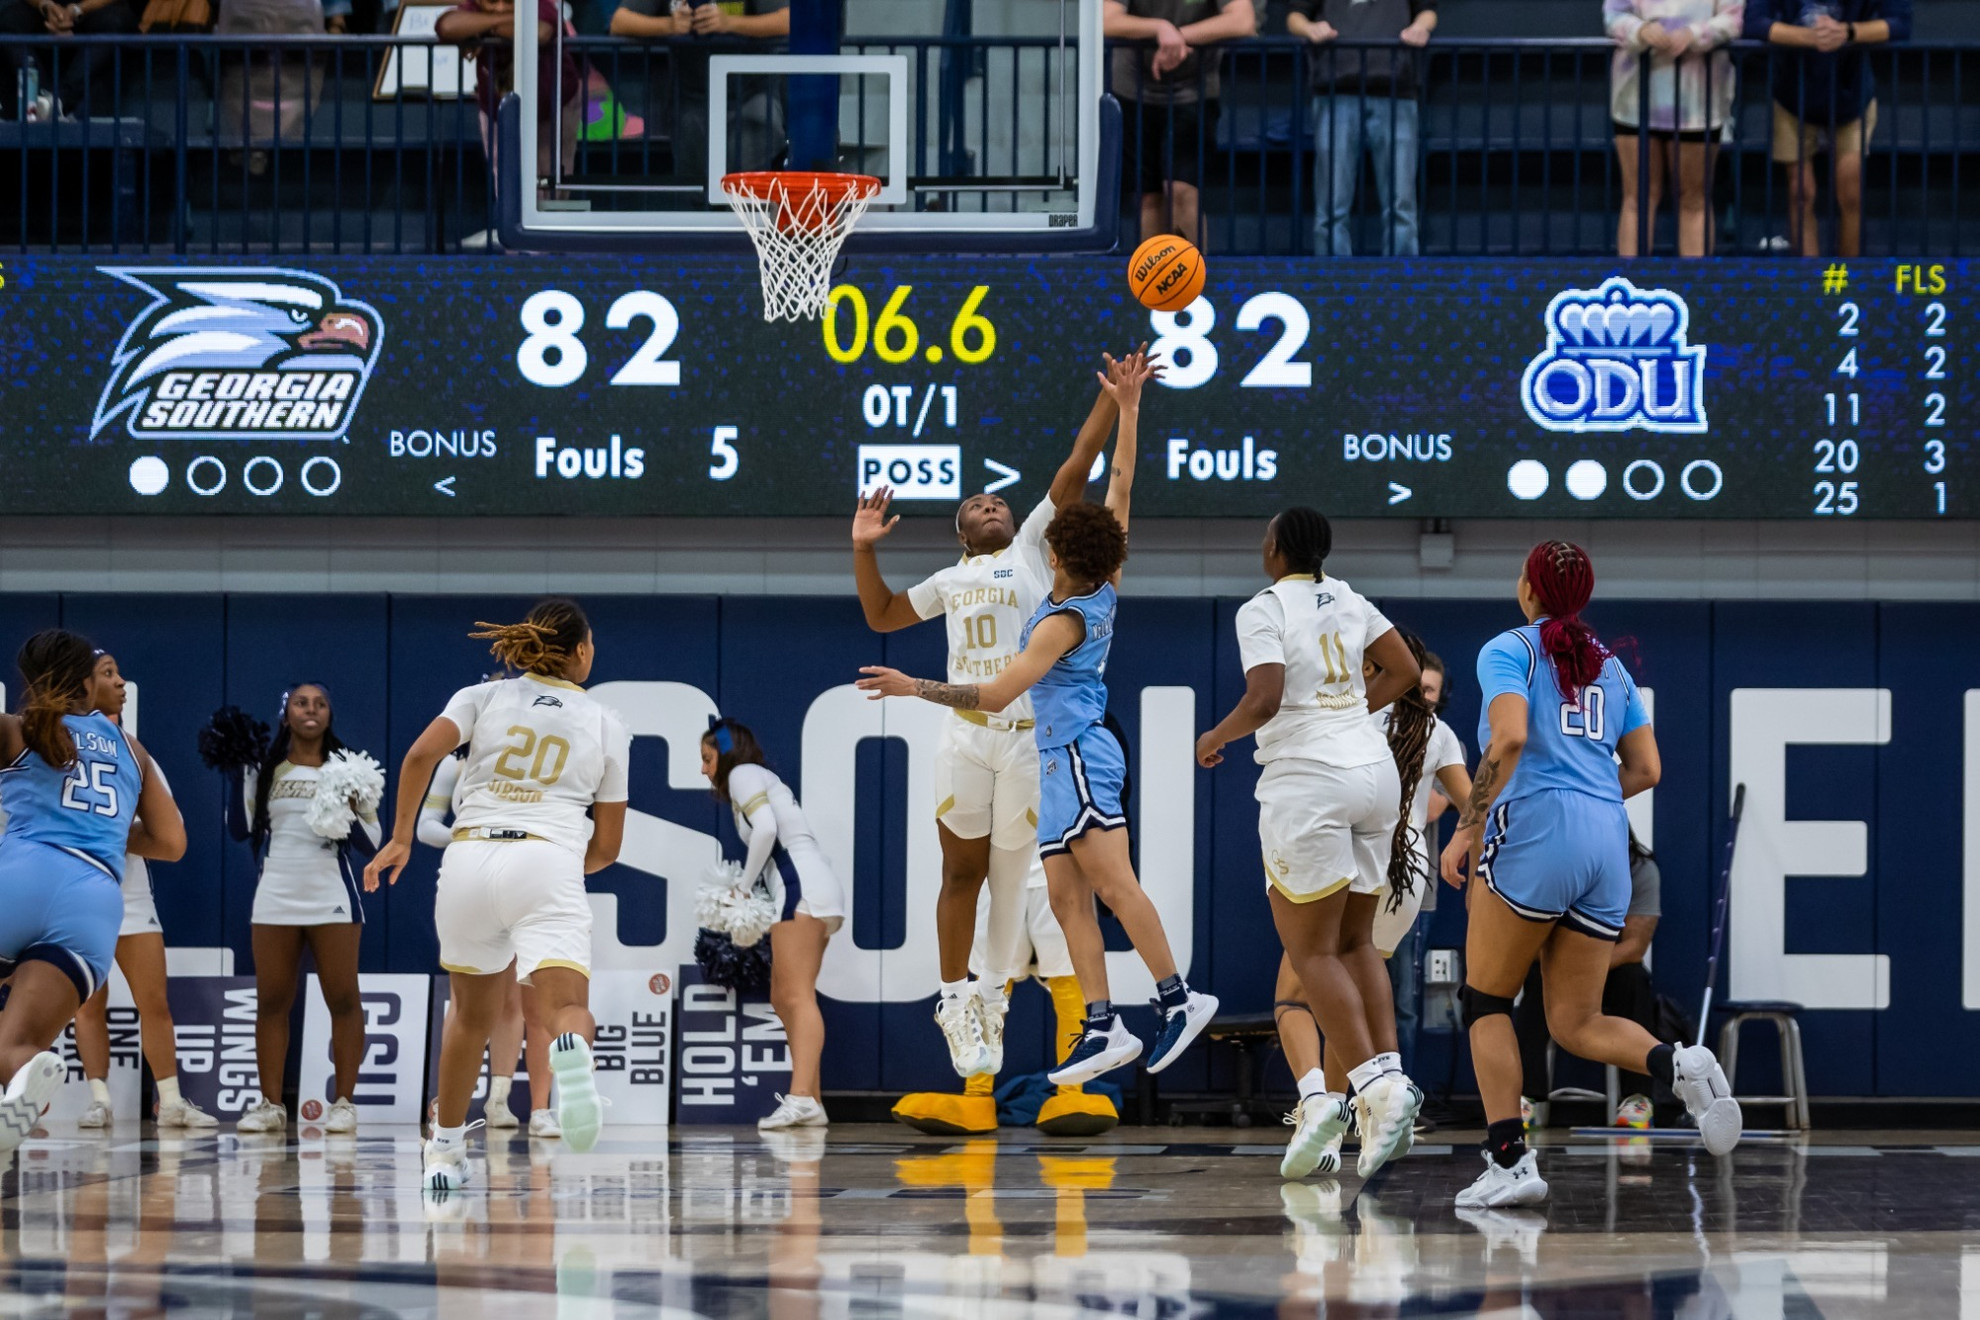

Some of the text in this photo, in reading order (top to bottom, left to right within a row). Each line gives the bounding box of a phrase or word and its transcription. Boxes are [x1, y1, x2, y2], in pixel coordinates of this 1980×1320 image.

[1048, 214, 1078, 228] DRAPER
[1135, 245, 1176, 282] Wilson
[1156, 262, 1188, 295] NCAA
[1895, 265, 1946, 294] FLS
[822, 285, 997, 364] 06.6
[1839, 303, 1946, 335] 2 2
[516, 289, 682, 388] 82
[1151, 290, 1313, 390] 82
[1838, 346, 1946, 378] 4 2
[156, 372, 354, 400] GEORGIA
[1533, 358, 1691, 418] ODU
[141, 400, 343, 428] SOUTHERN
[1825, 392, 1946, 424] 11 2
[389, 430, 497, 458] BONUS
[535, 425, 738, 481] Fouls 5
[1167, 436, 1277, 481] Fouls
[1343, 433, 1452, 462] BONUS
[1814, 440, 1945, 473] 20 3
[864, 458, 954, 485] POSS
[1814, 480, 1946, 515] 25 1
[951, 587, 1019, 614] EORGIA
[963, 614, 997, 649] 10
[1318, 631, 1351, 685] 11
[1560, 684, 1605, 741] 20
[69, 732, 118, 758] LSON
[493, 724, 571, 786] 20
[61, 757, 119, 818] 25
[105, 1006, 140, 1070] ONE
[173, 1025, 215, 1073] UP
[216, 988, 263, 1113] WINGS
[592, 1025, 626, 1071] BIG
[630, 1011, 666, 1085] BLUE
[682, 983, 736, 1106] HOLD
